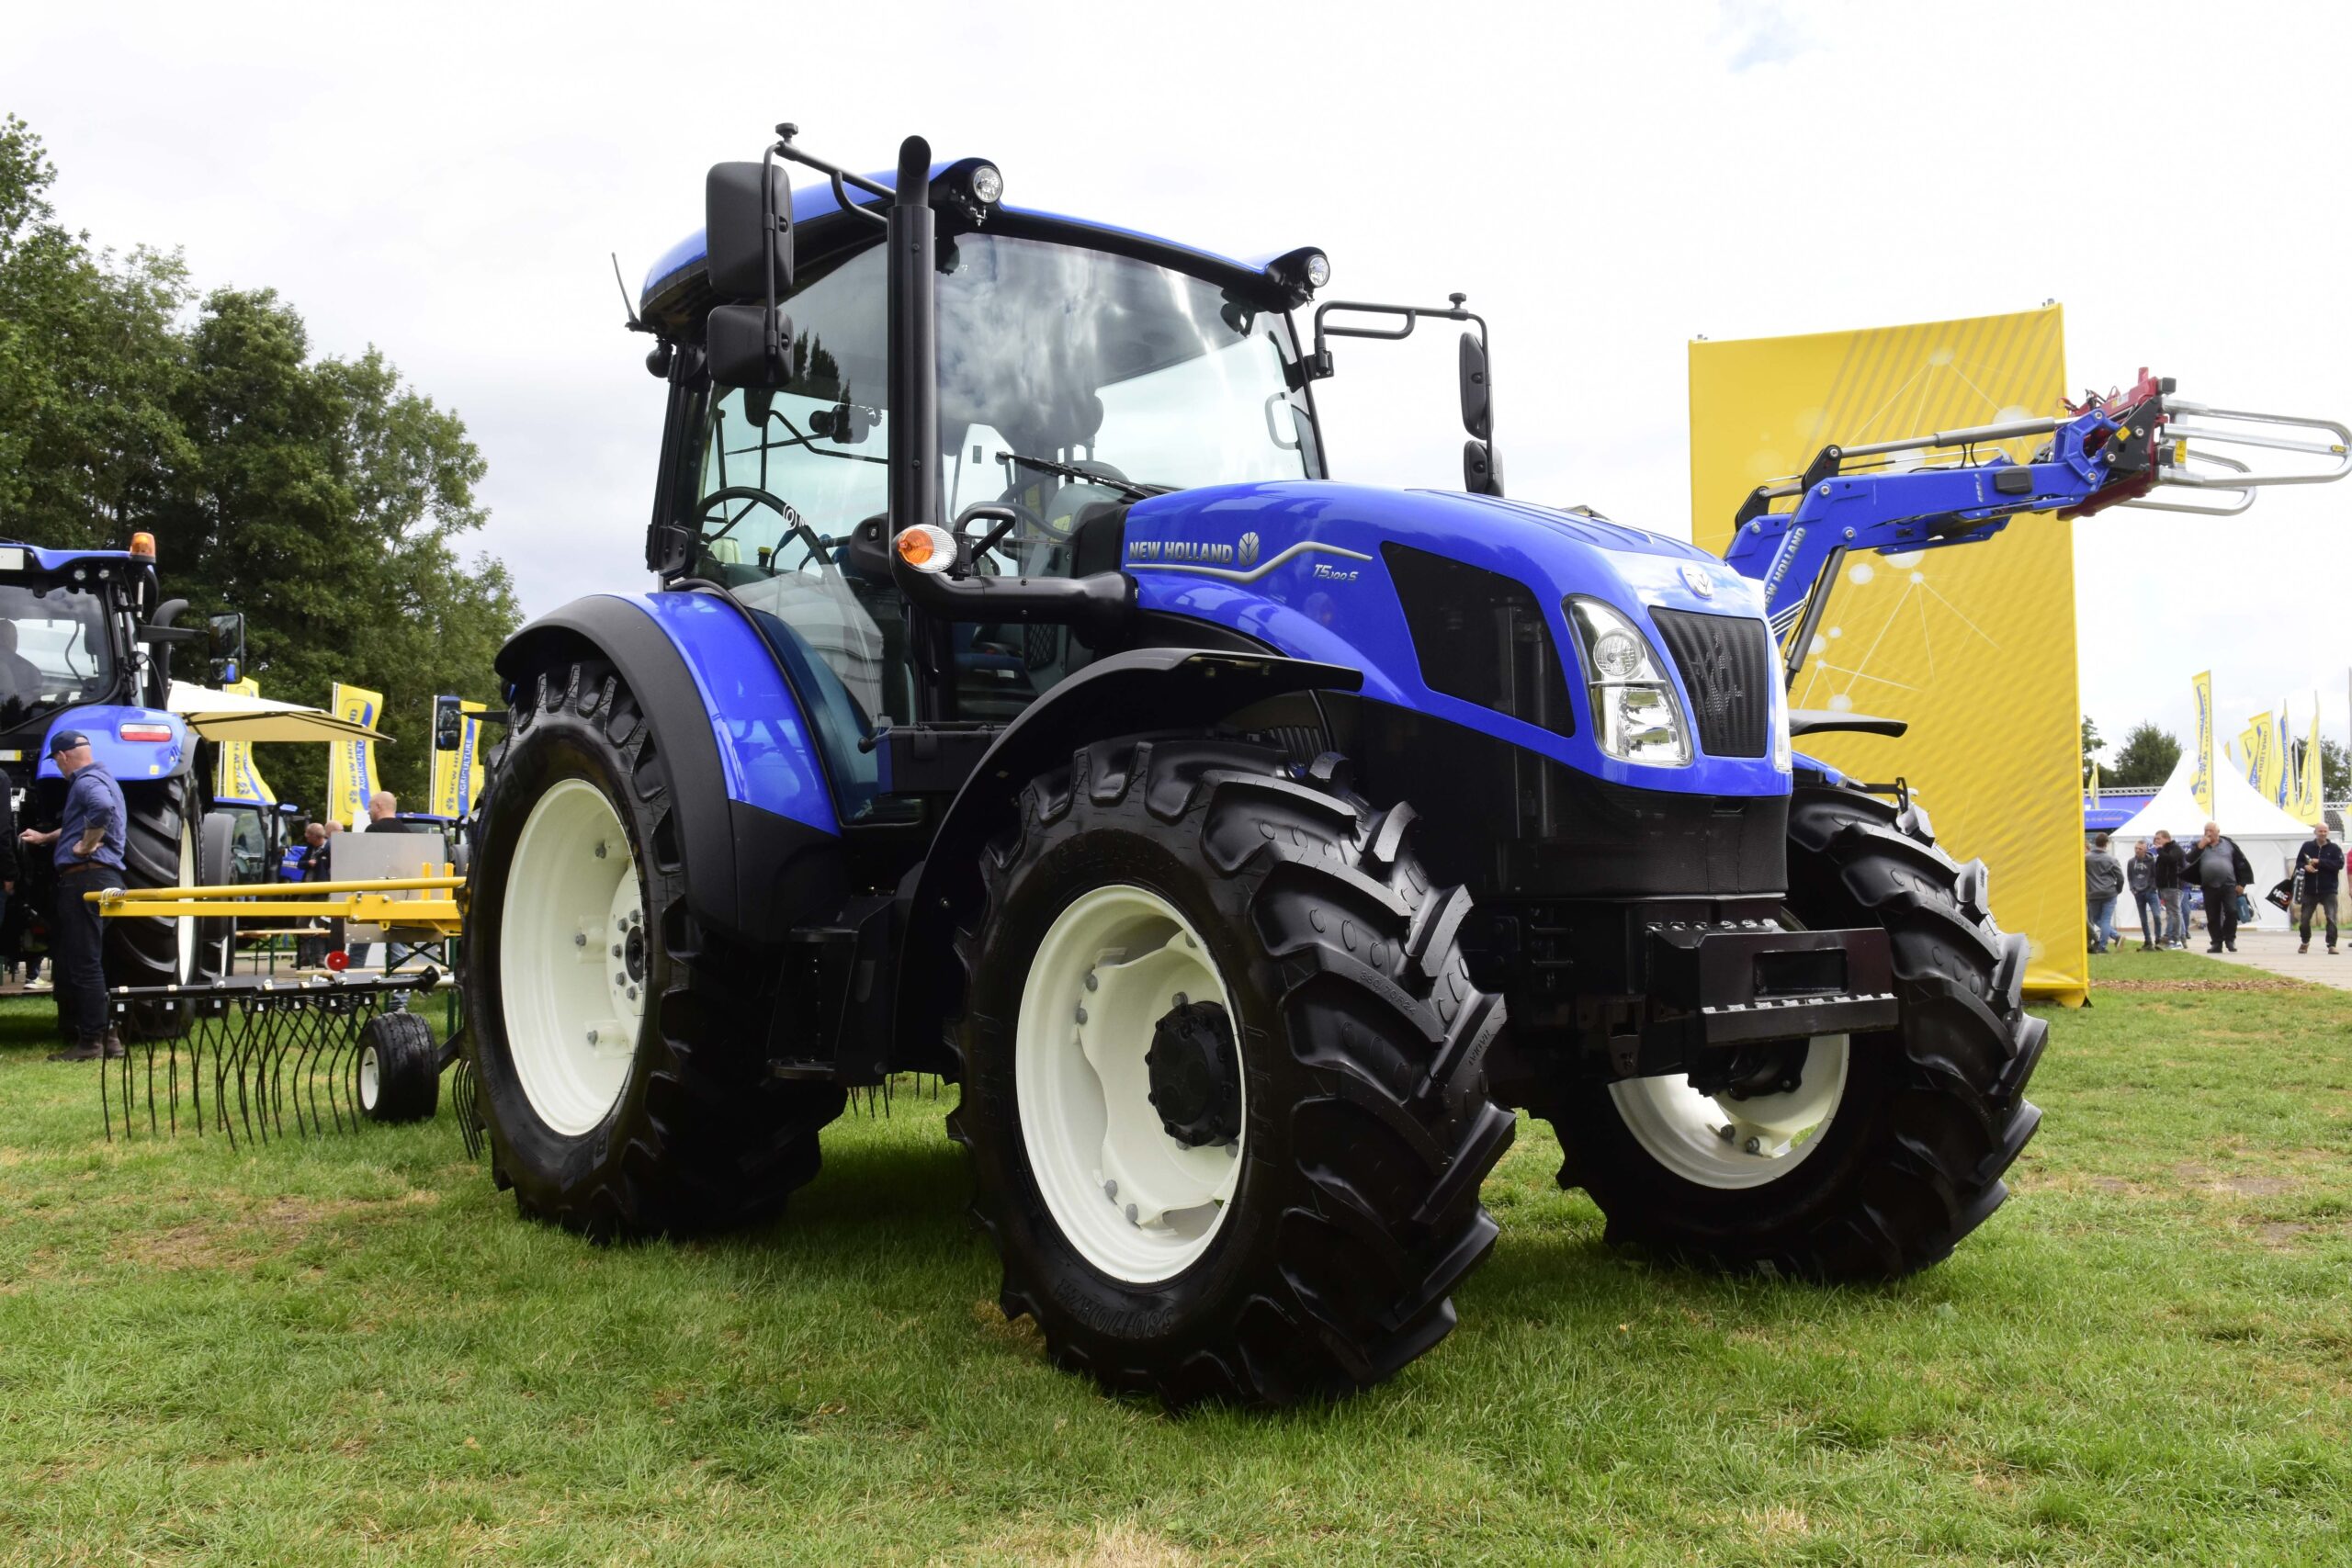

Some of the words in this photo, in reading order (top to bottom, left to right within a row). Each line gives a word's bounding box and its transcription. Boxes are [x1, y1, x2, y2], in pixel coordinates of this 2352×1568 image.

[1129, 541, 1161, 560] NEW
[1164, 542, 1233, 564] HOLLAND
[1772, 527, 1806, 582] HOLLAND
[356, 740, 368, 790] AGRICULTU
[459, 739, 473, 796] AGRICULTURE
